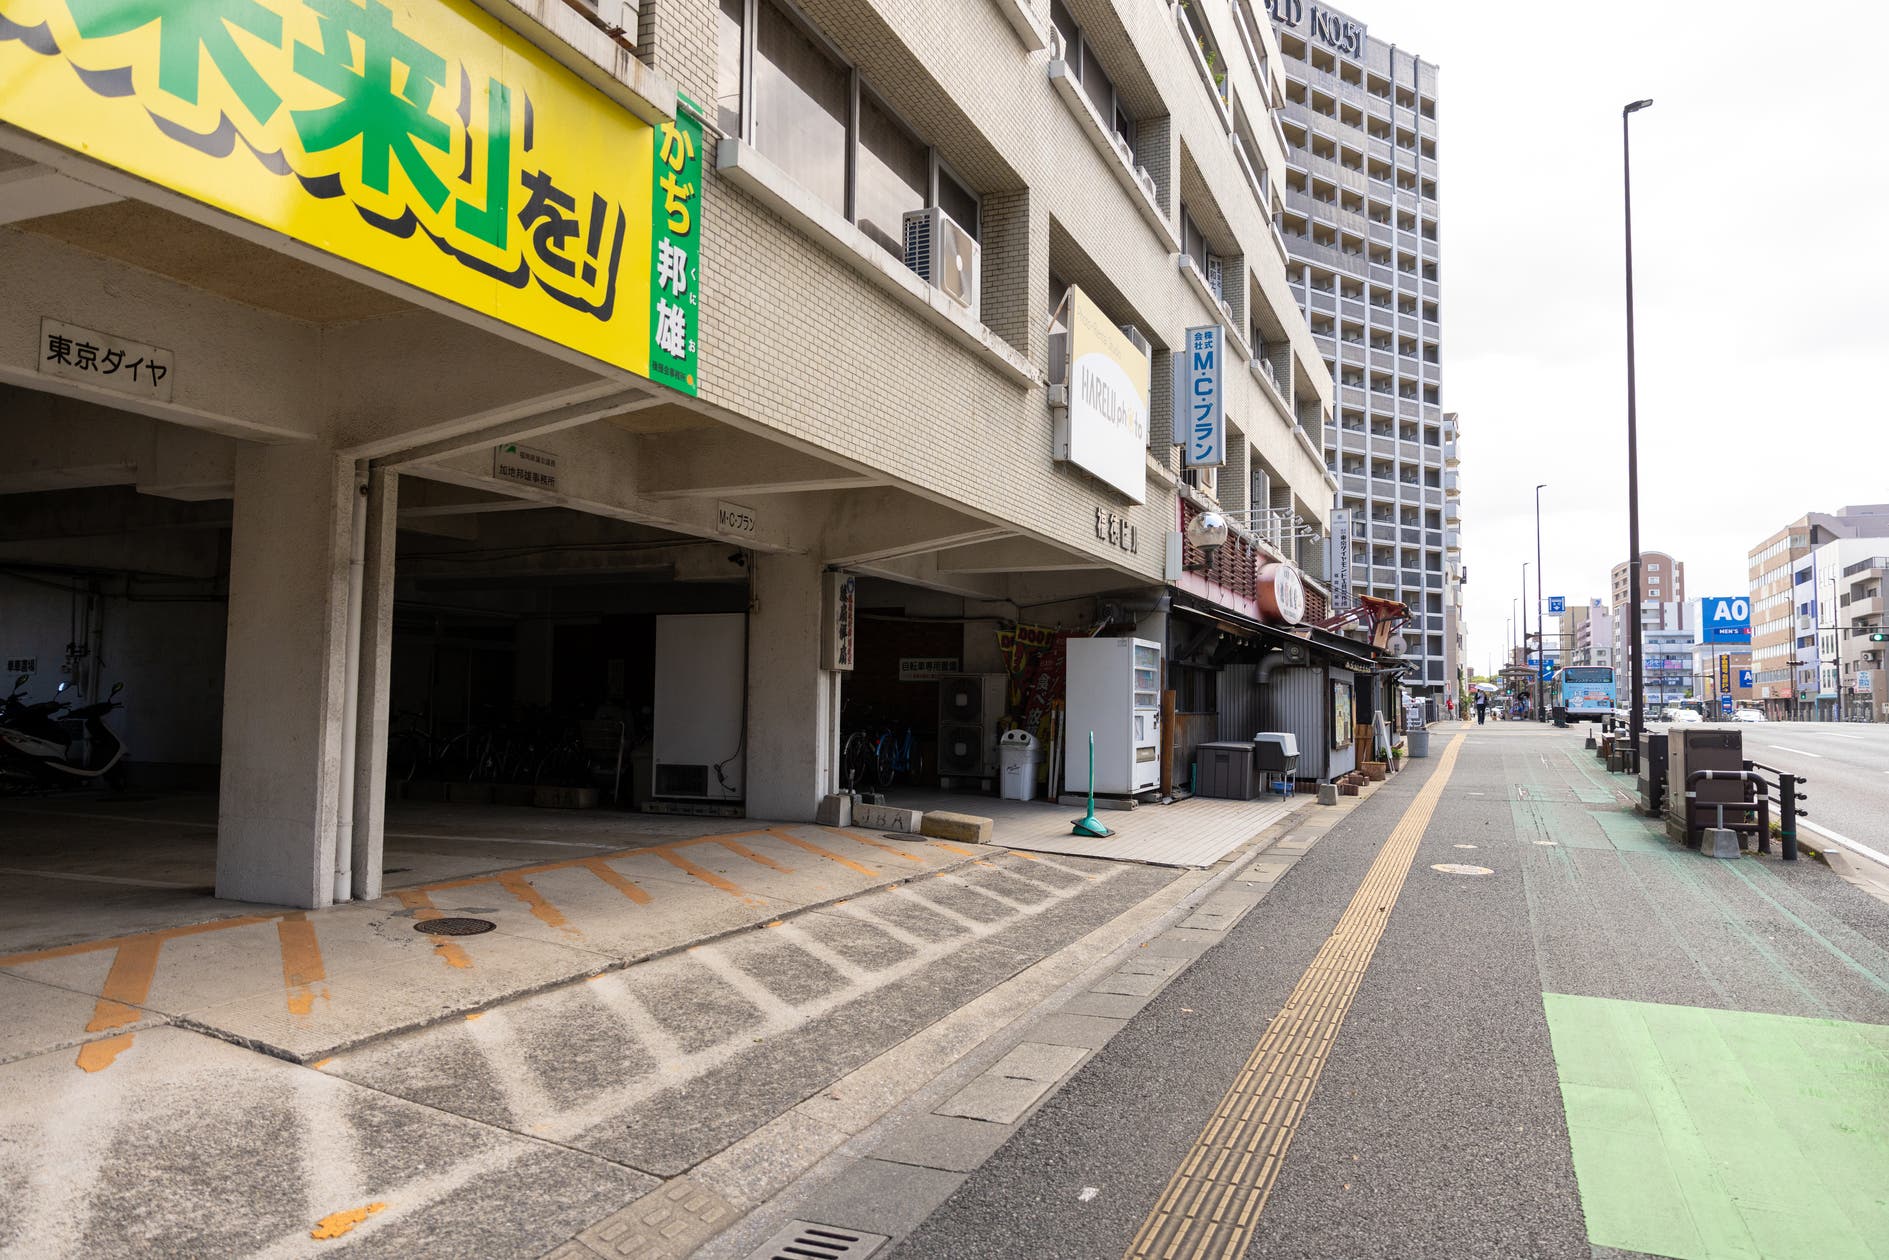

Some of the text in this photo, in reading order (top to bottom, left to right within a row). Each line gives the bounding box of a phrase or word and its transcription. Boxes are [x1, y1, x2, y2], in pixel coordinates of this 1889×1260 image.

[47, 334, 167, 387] 東京ダイヤ
